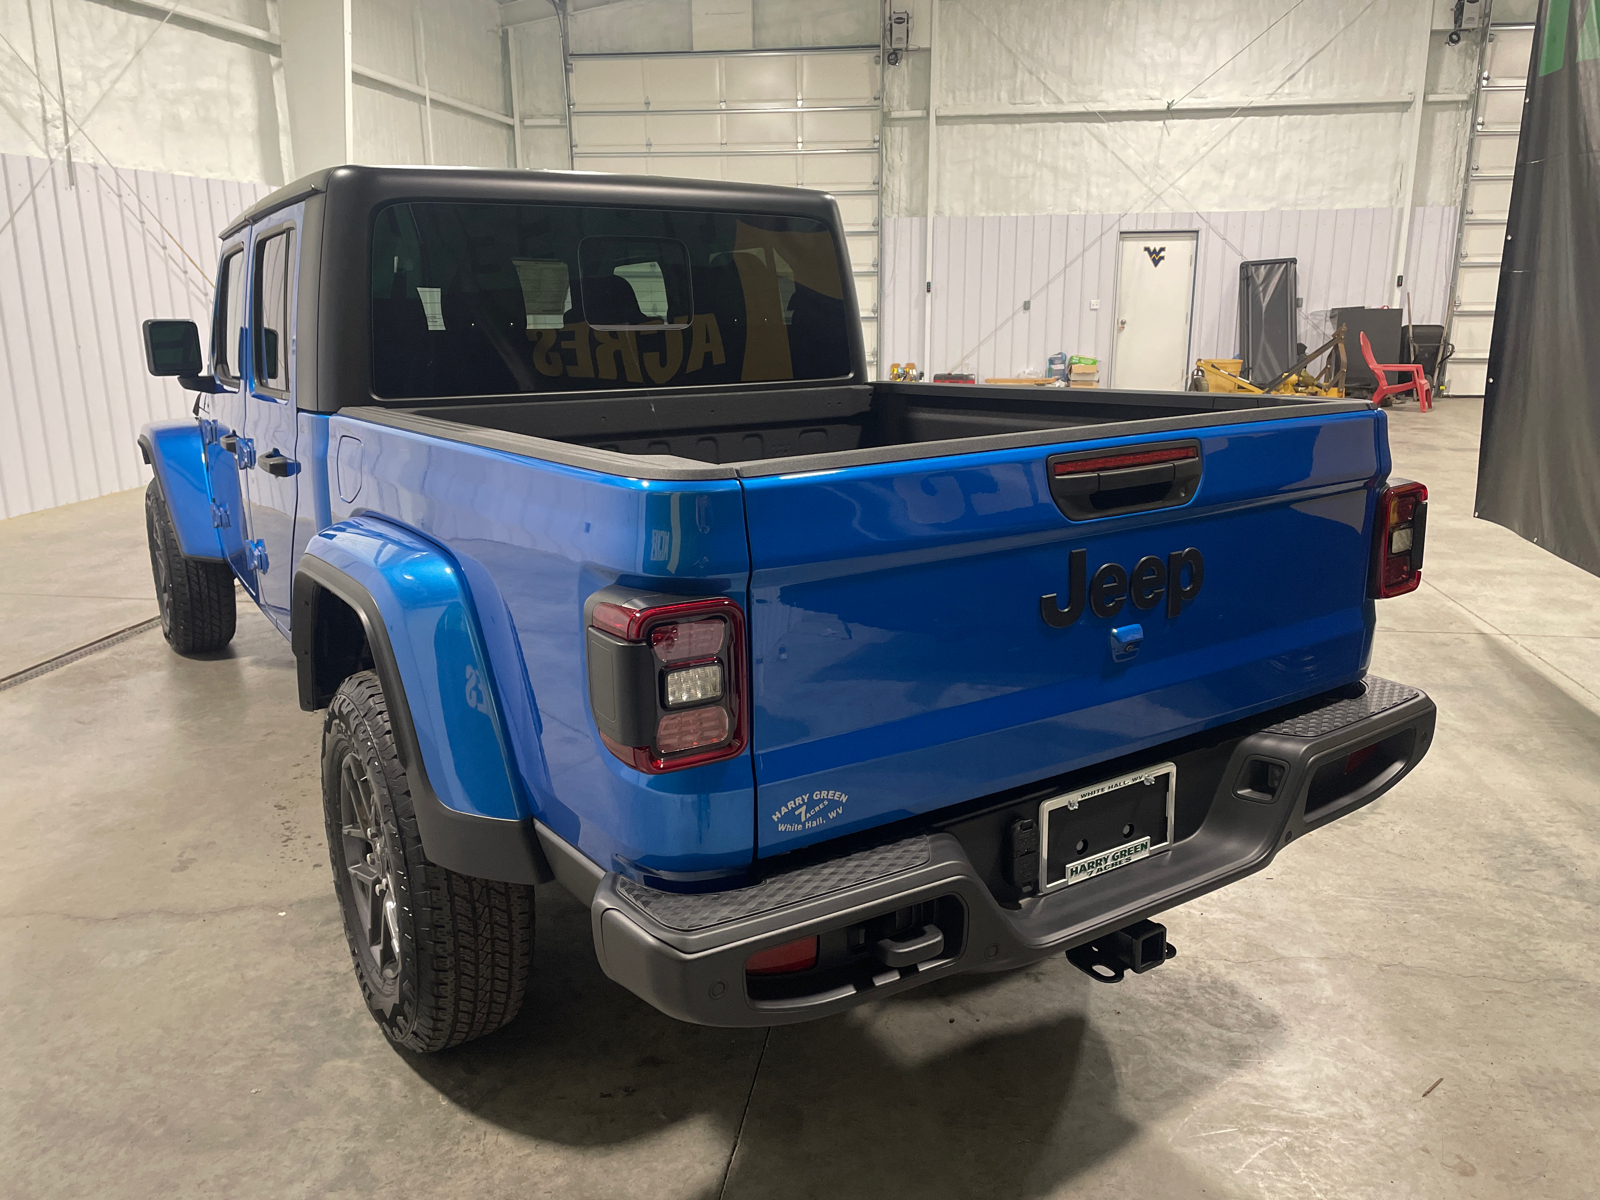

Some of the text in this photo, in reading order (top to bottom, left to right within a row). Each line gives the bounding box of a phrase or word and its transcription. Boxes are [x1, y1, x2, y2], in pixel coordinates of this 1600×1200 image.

[1041, 546, 1204, 628] Jeep
[771, 790, 848, 822] HARRY GREEN
[1080, 787, 1105, 799] WHITE
[778, 806, 843, 832] White Hall, WV
[795, 800, 828, 822] 7 ACRES
[1070, 841, 1148, 877] HARRY GREEN
[1096, 857, 1131, 874] ACRES
